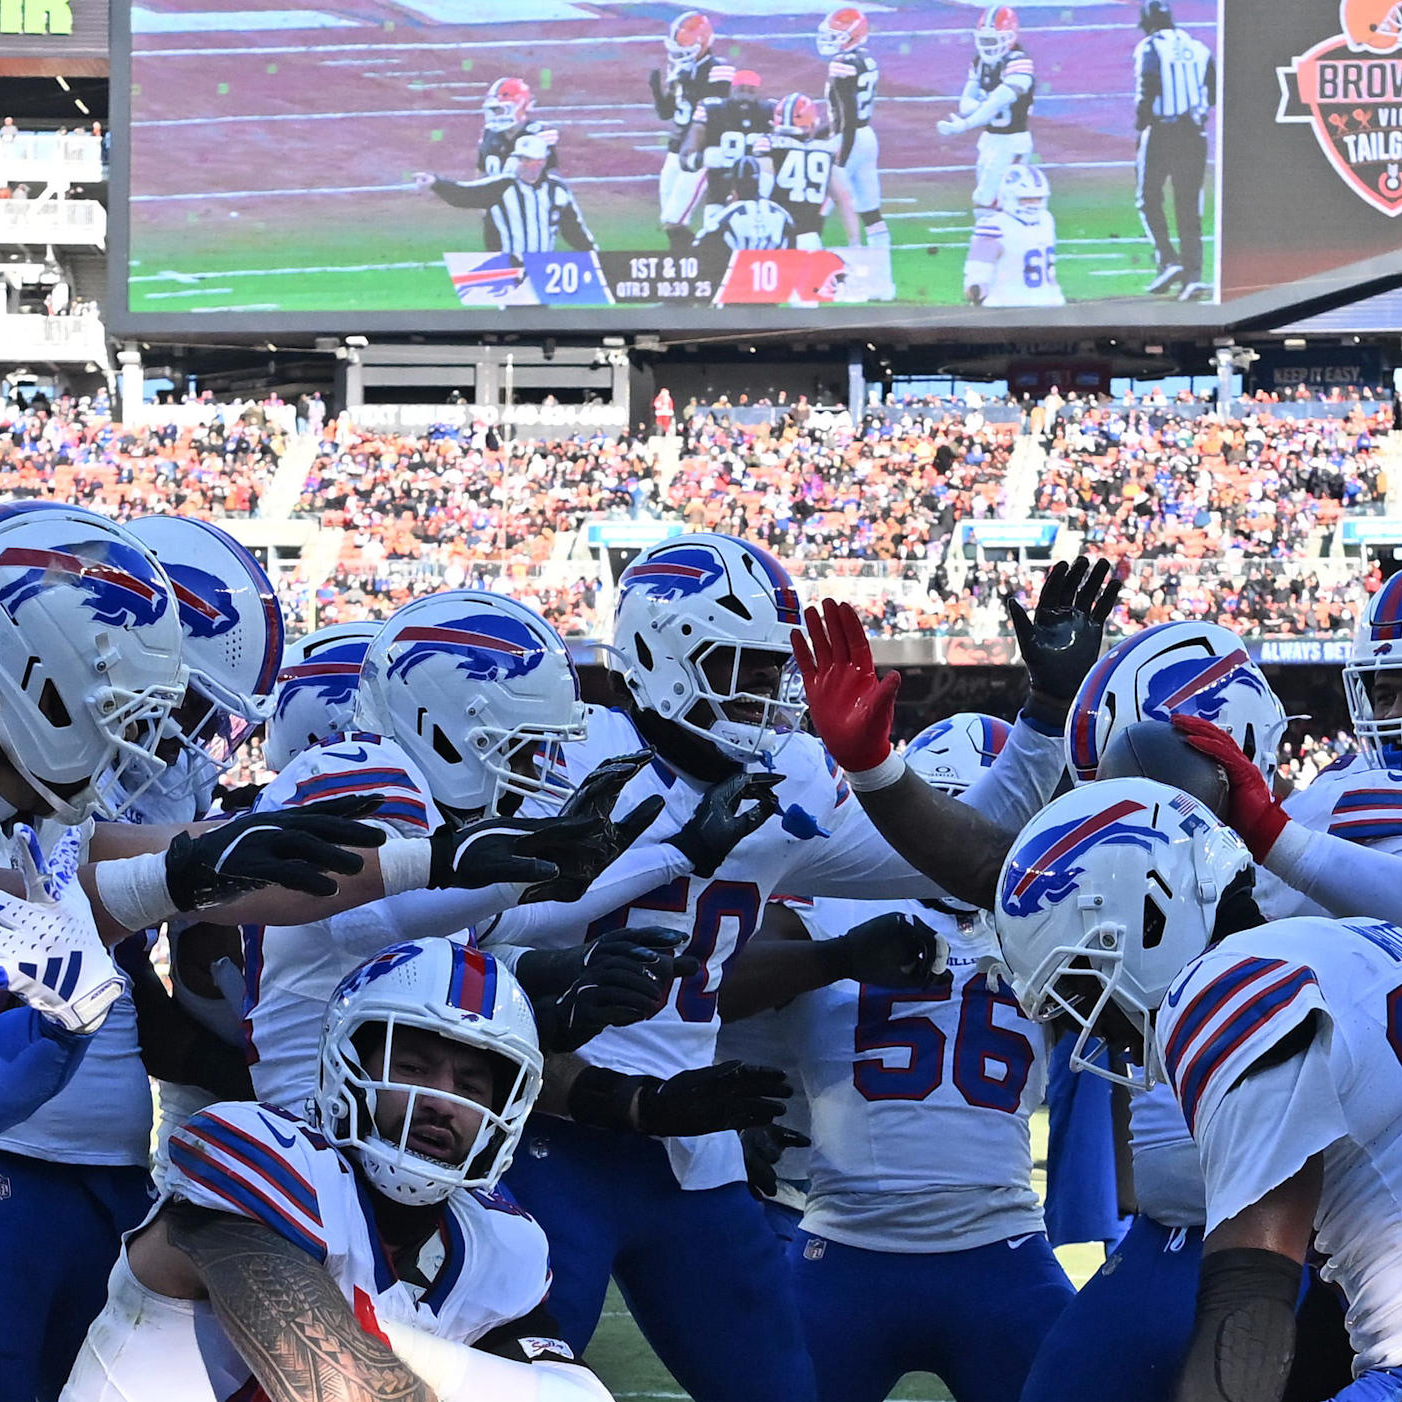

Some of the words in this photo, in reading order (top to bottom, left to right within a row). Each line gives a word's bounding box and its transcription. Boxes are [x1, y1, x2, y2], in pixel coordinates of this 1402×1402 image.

[776, 148, 832, 204] 49
[544, 262, 579, 294] 20
[629, 257, 659, 279] 1ST
[663, 257, 677, 278] &
[679, 256, 698, 279] 10
[750, 260, 779, 293] 10
[695, 281, 713, 297] 25
[852, 971, 1035, 1115] 56
